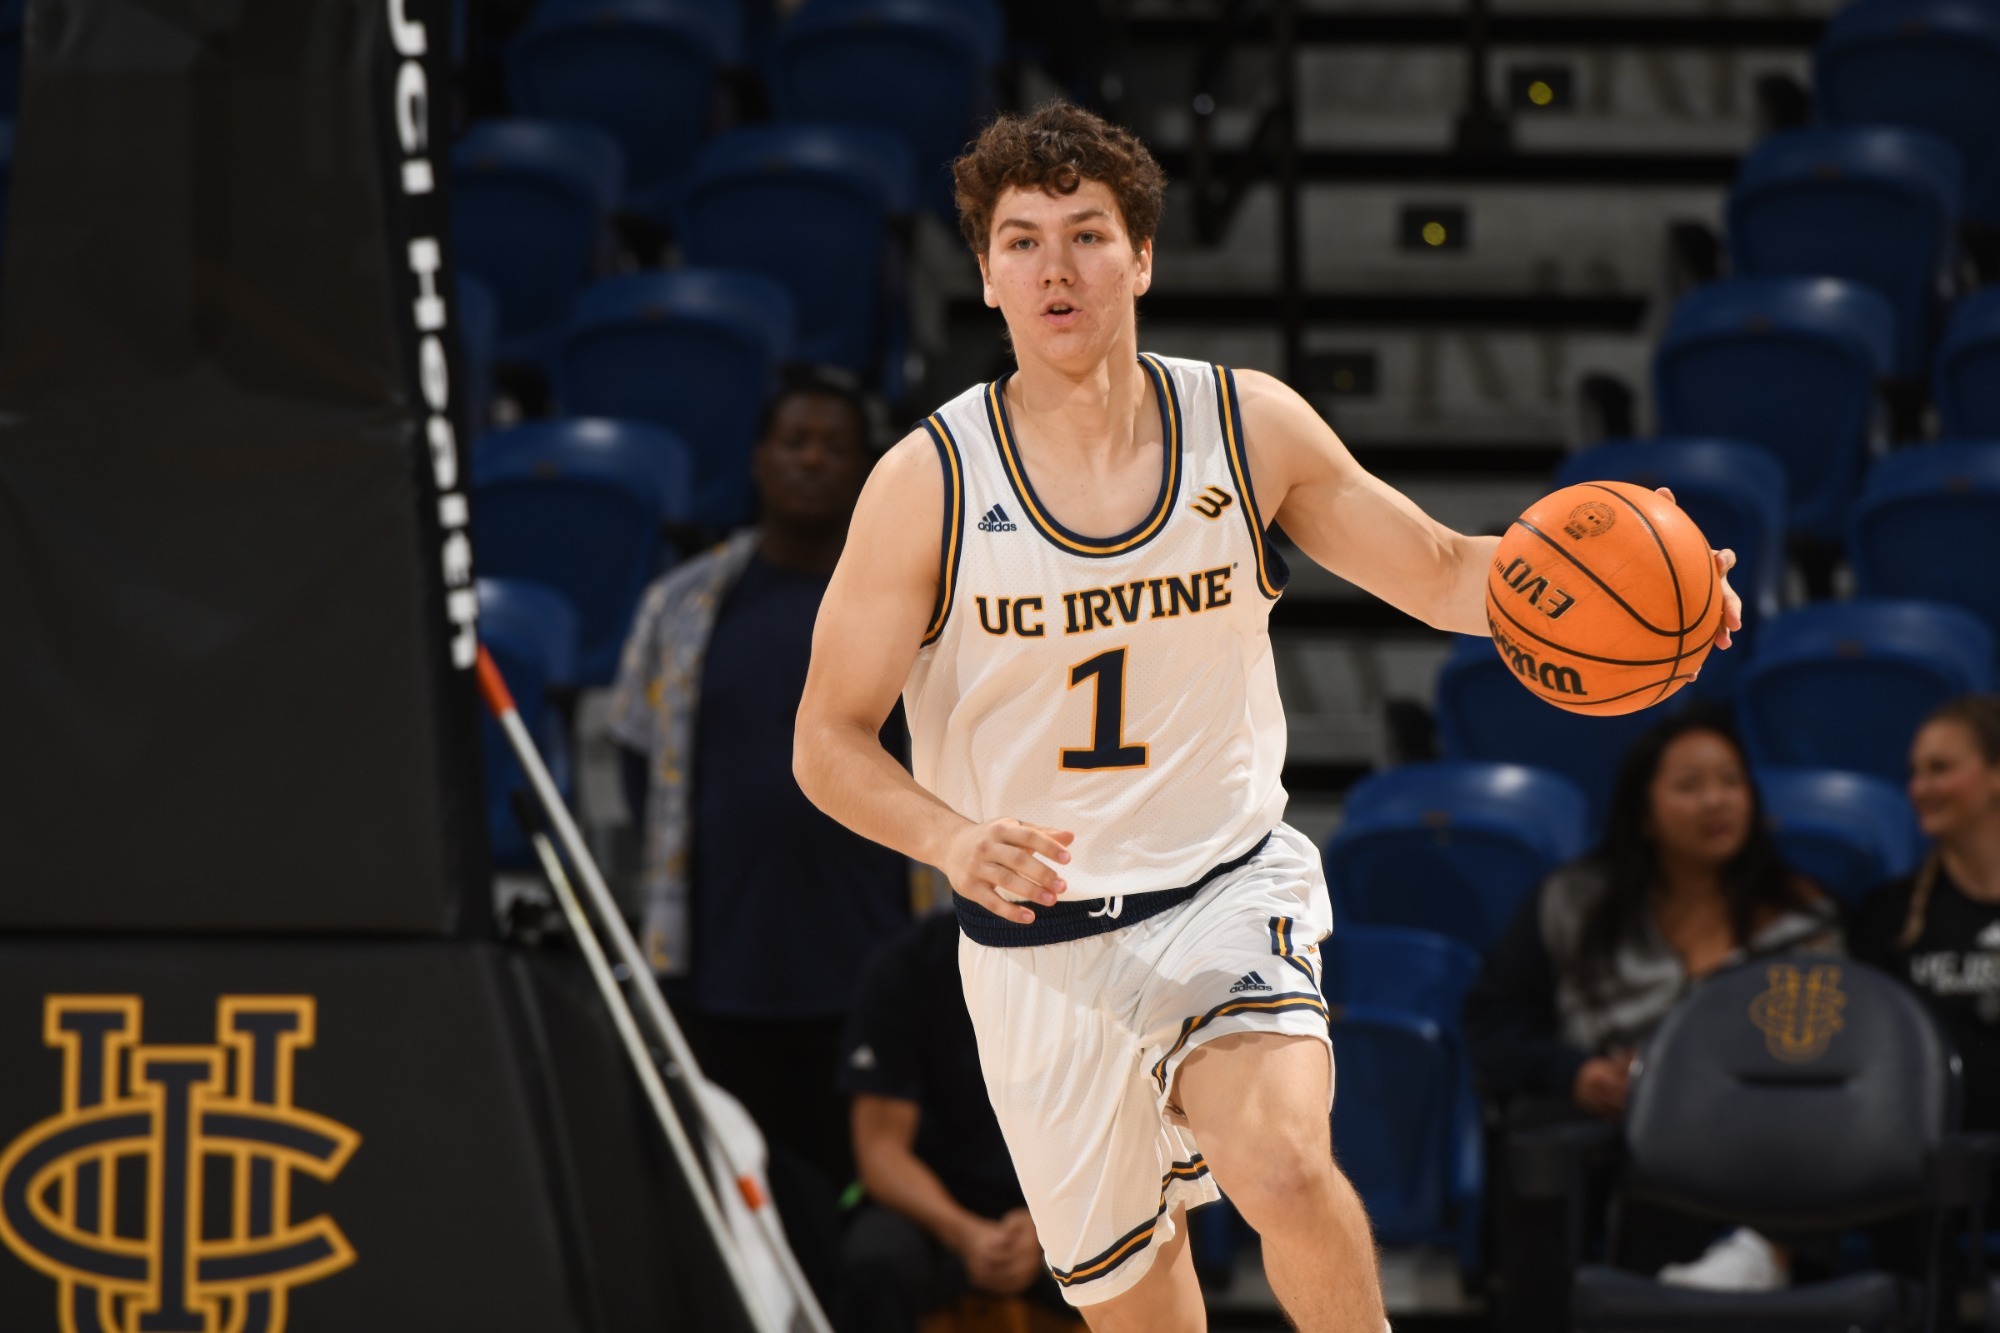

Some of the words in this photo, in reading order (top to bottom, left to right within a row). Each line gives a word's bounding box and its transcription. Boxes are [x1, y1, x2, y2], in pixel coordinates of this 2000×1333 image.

[977, 520, 1018, 533] adidas
[974, 594, 1046, 639] UC
[1061, 562, 1233, 637] IRVINE
[1502, 555, 1577, 620] EVO
[1486, 605, 1589, 696] Wilso
[1057, 644, 1150, 772] 1
[1229, 983, 1273, 994] adidas
